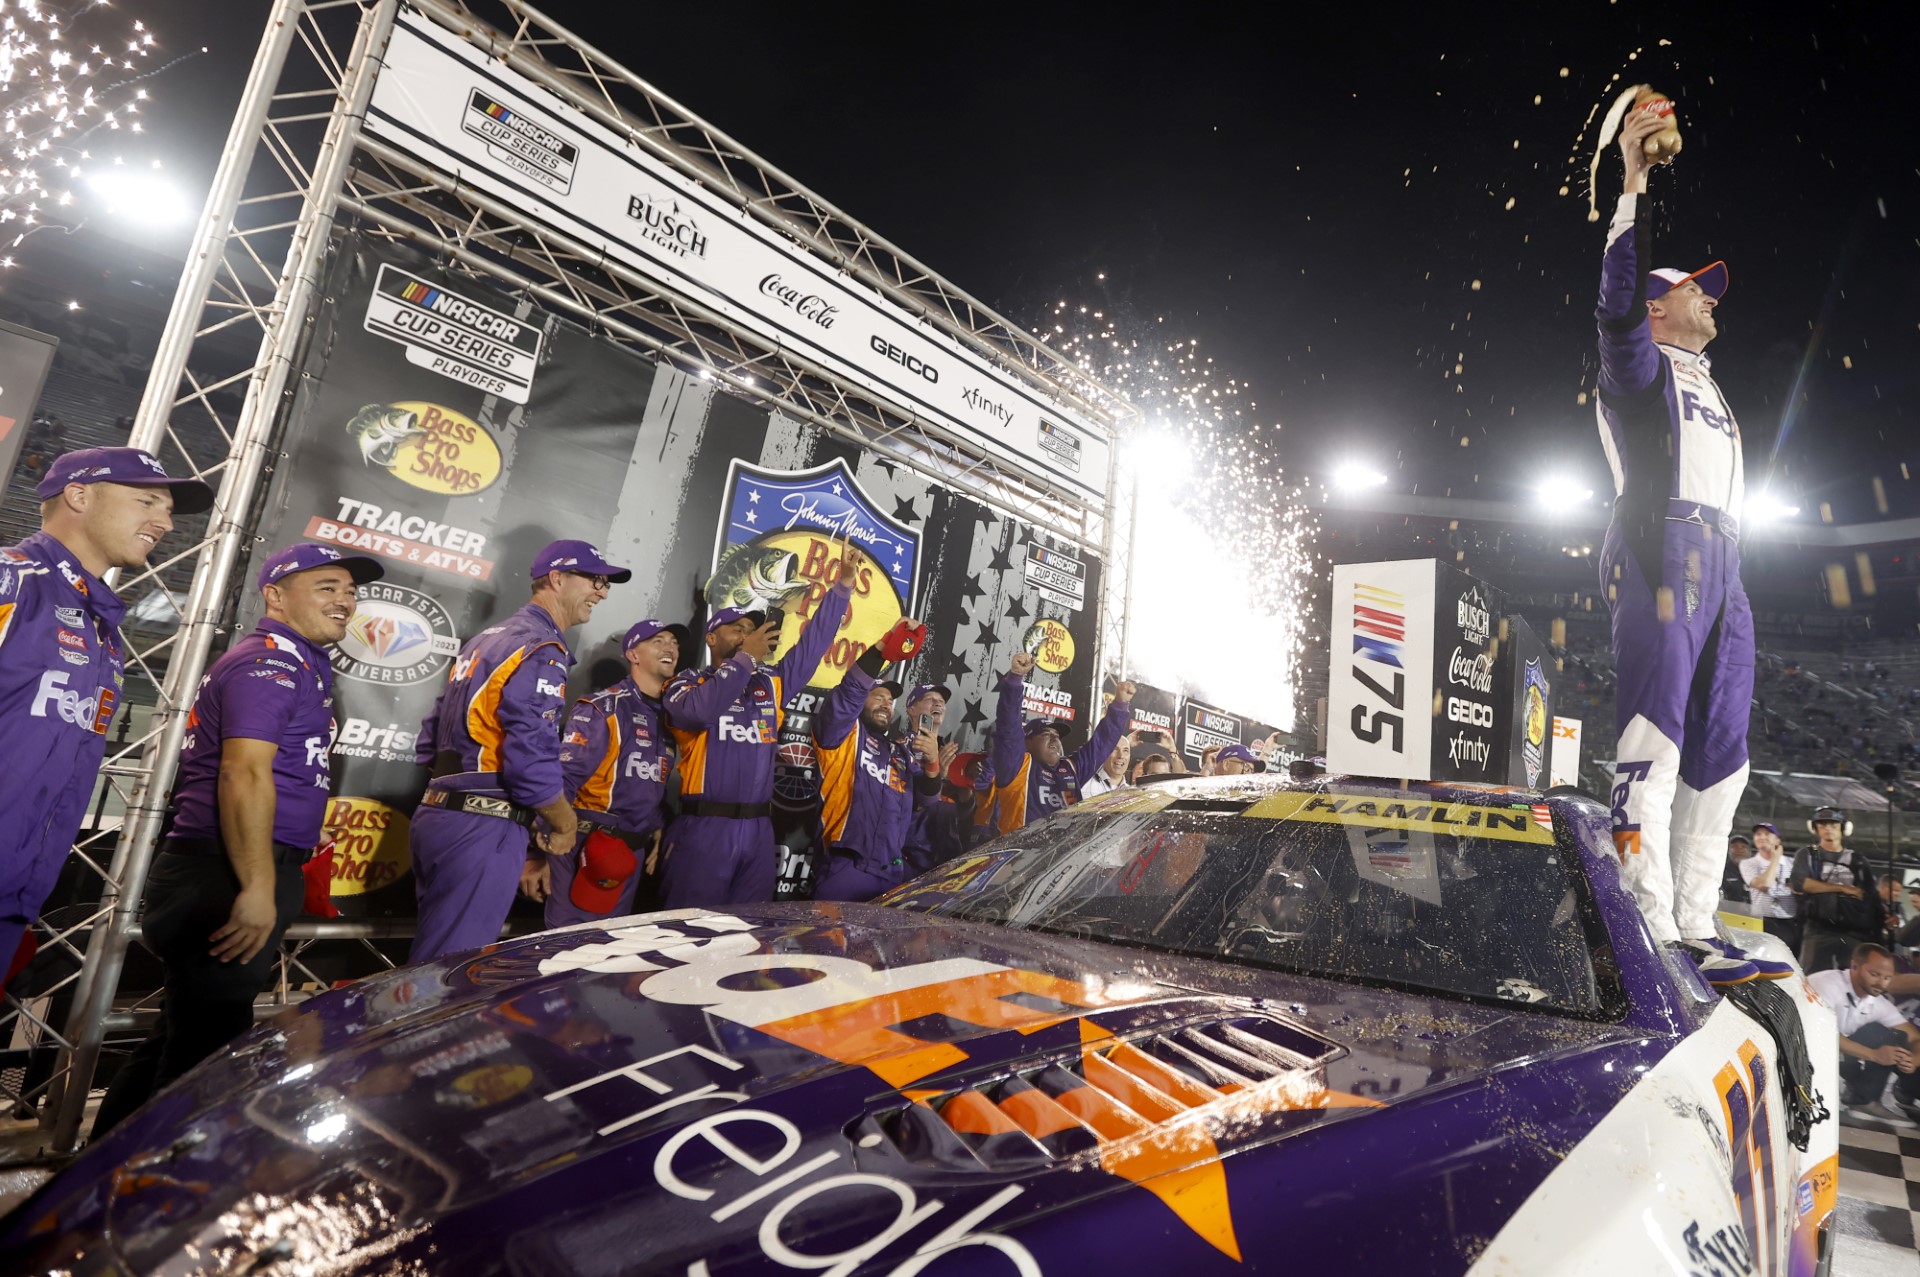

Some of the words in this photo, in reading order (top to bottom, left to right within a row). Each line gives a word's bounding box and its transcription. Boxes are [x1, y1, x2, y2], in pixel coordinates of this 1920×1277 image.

[480, 120, 513, 145] CUP
[511, 135, 561, 170] SERIES
[503, 111, 564, 153] NASCAR
[504, 155, 555, 186] PLAYOFFS
[626, 194, 708, 257] BUSCH
[640, 226, 687, 259] LIGHT
[430, 294, 520, 343] NASCAR
[393, 309, 439, 337] CUP
[440, 328, 515, 369] SERIES
[432, 357, 507, 394] PLAYOFFS
[870, 335, 939, 384] GEICO
[962, 385, 1015, 428] xfinity
[1682, 390, 1736, 438] Fed
[417, 405, 478, 444] Bass
[415, 430, 460, 461] Pro
[410, 451, 482, 492] Shops
[337, 496, 487, 557] TRACKER
[781, 493, 840, 541] Johnny
[828, 508, 892, 545] Morris
[315, 521, 404, 557] BOATS
[407, 547, 421, 561] &
[422, 551, 482, 578] ATVs
[799, 538, 872, 595] Bas
[1045, 552, 1078, 575] NASCAR
[1034, 567, 1050, 580] CUP
[1050, 573, 1077, 591] SERIES
[354, 586, 403, 603] SCAR
[408, 594, 446, 628] 75TH
[1457, 600, 1490, 638] BUSCH
[435, 641, 456, 651] 2023
[1045, 636, 1060, 652] Pro
[1046, 621, 1066, 641] Bass
[266, 658, 298, 672] NASCAR
[327, 645, 438, 681] NNIVERSARY
[1043, 648, 1069, 670] Shops
[30, 669, 115, 735] FedE
[536, 678, 566, 698] FedE
[1021, 681, 1072, 707] TRACKER
[1022, 698, 1044, 713] OATS
[1050, 706, 1072, 719] ATVs
[1134, 708, 1170, 729] TRACKER
[1204, 712, 1234, 735] NASCAR
[1351, 664, 1405, 754] 75
[1448, 696, 1493, 729] GEICO
[337, 718, 417, 751] Bris
[1193, 732, 1209, 748] CUP
[1449, 730, 1490, 771] xfinity
[332, 743, 377, 758] Motor
[379, 749, 417, 762] Spee
[324, 800, 393, 830] Bass
[1303, 798, 1527, 832] HAMLIN
[333, 827, 373, 856] Pro
[330, 853, 398, 889] Shops
[777, 880, 797, 892] tor
[544, 1044, 1042, 1277] Freigh
